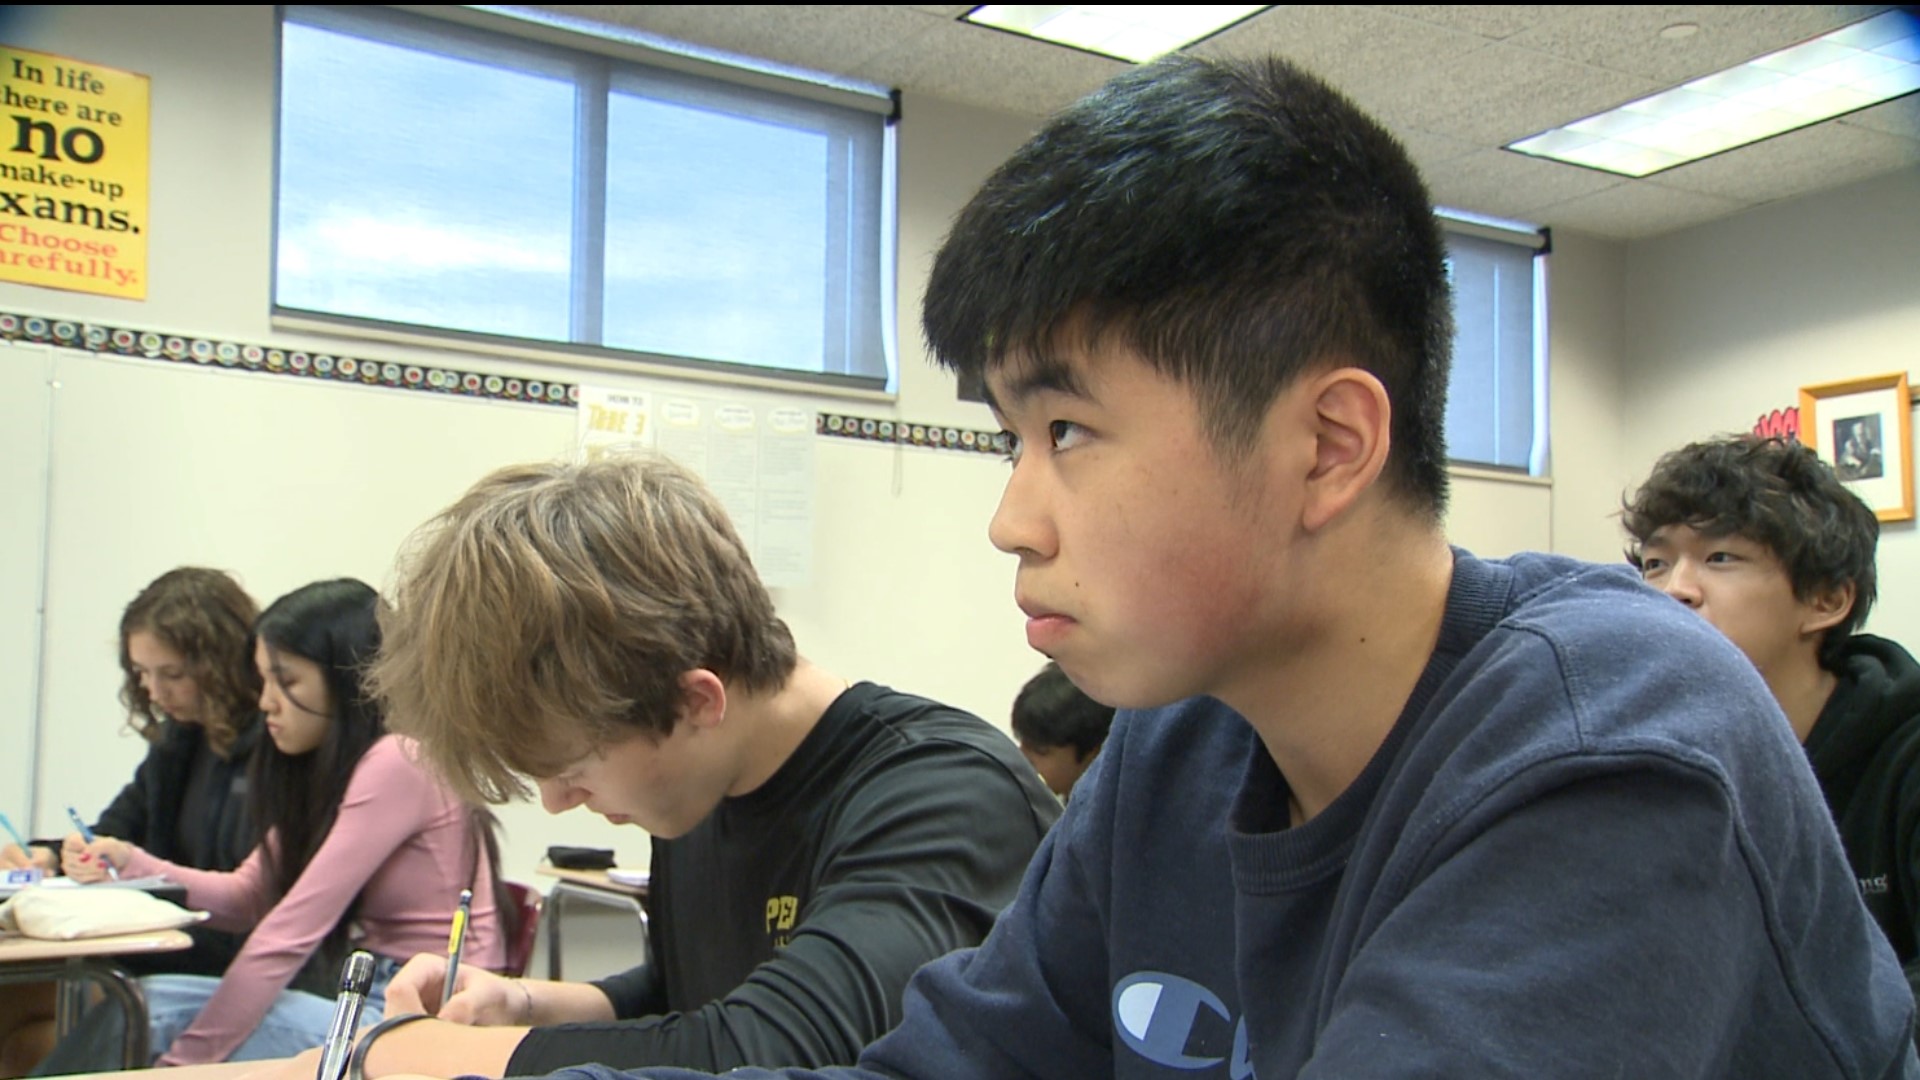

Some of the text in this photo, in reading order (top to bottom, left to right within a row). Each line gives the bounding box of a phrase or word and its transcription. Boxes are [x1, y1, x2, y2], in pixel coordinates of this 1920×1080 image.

[11, 57, 105, 95] In life
[0, 84, 122, 127] here are
[9, 114, 105, 164] no
[0, 190, 140, 235] xams.
[0, 222, 118, 259] Choose
